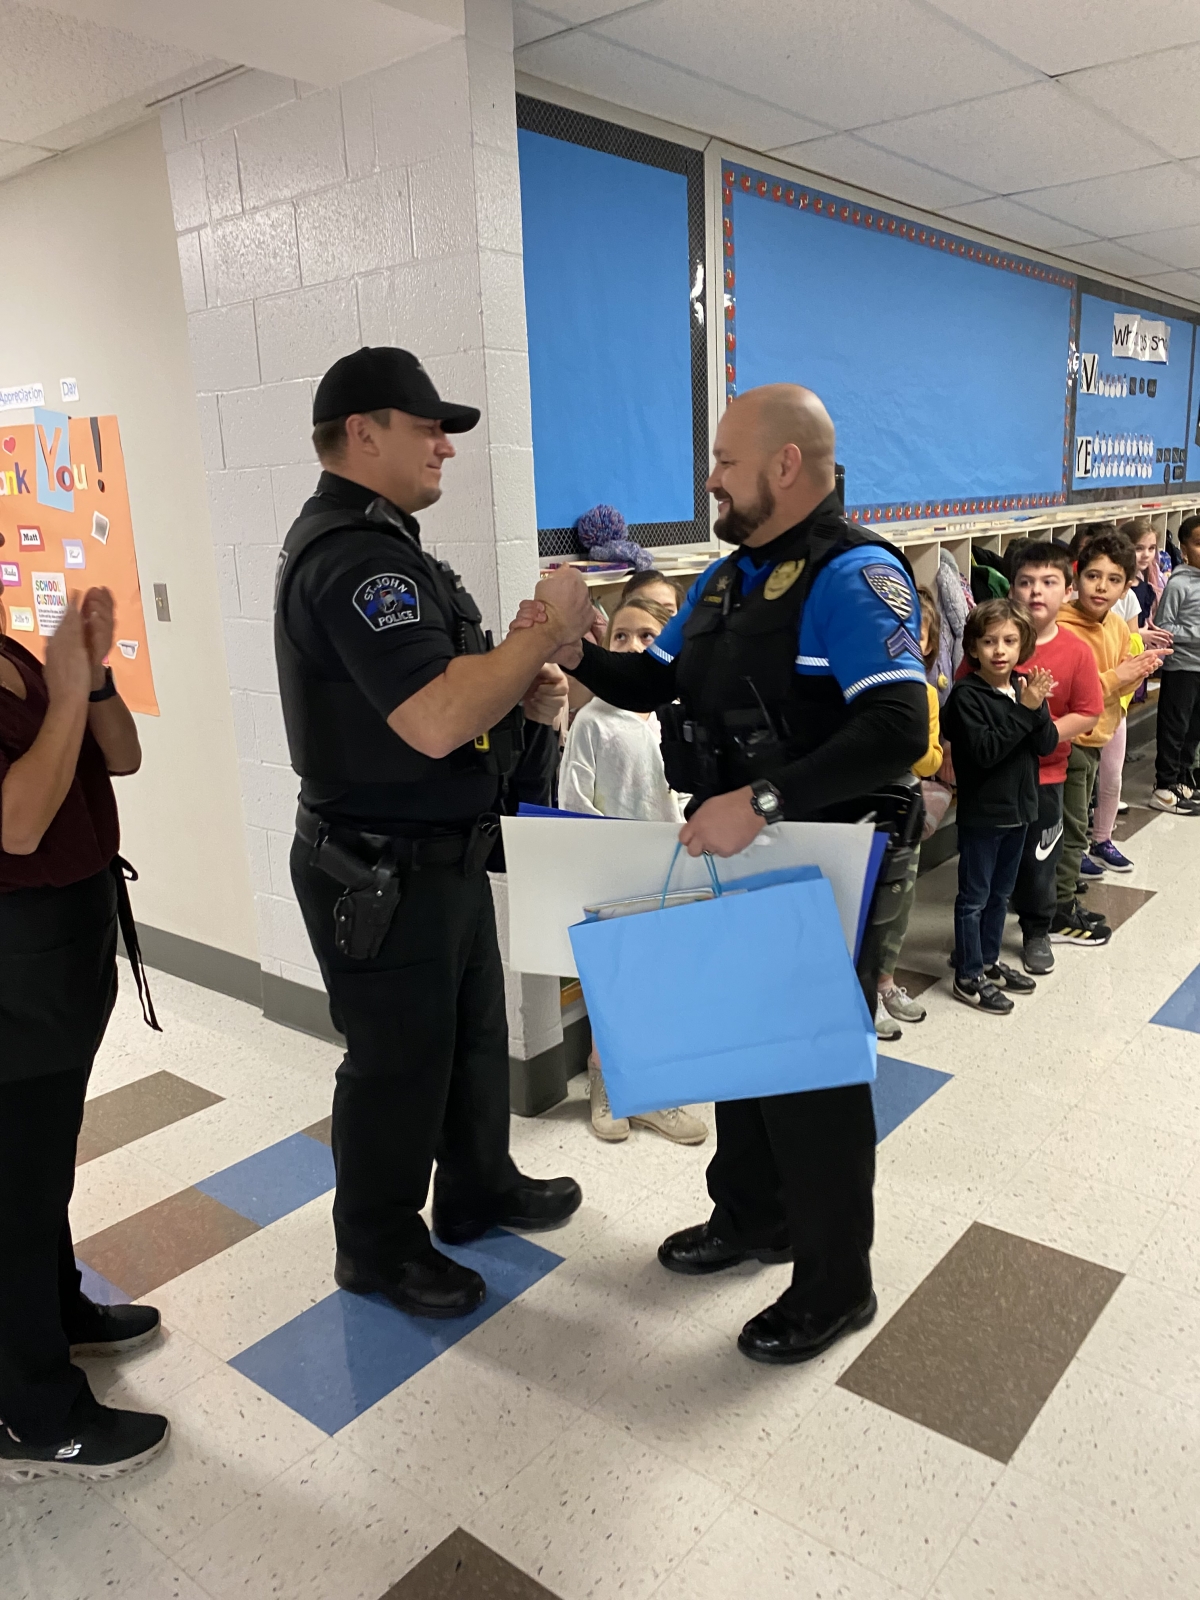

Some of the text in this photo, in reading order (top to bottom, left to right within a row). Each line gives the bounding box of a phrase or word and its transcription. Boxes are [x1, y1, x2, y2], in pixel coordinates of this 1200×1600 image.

[61, 381, 77, 397] Day
[22, 533, 39, 542] Matt
[35, 580, 61, 592] SCHOOL
[36, 594, 66, 606] CUSTODIAN
[378, 610, 414, 627] POLICE
